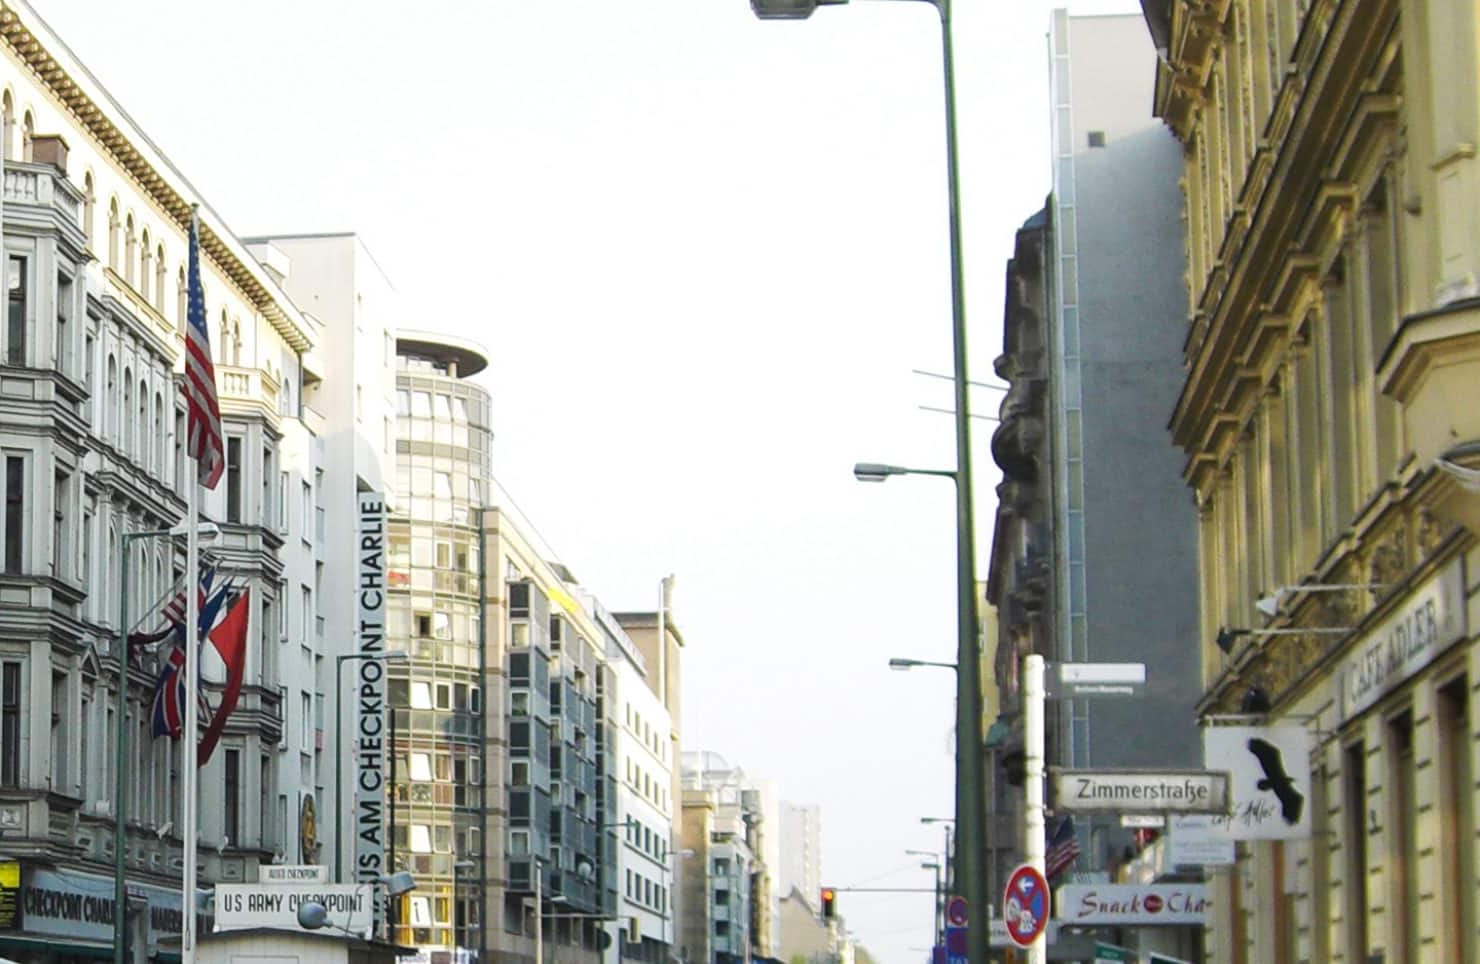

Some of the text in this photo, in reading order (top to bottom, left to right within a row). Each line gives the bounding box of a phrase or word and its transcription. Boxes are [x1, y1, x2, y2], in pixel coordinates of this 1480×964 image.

[360, 501, 383, 611] CHARLIE
[1386, 597, 1438, 675] ADLER
[1077, 778, 1208, 804] Zimmerstraße
[359, 800, 381, 846] AM
[24, 886, 82, 920] CHECKPOINT
[83, 894, 117, 926] CHARL
[248, 894, 284, 912] ARMY
[1078, 891, 1141, 917] Snack
